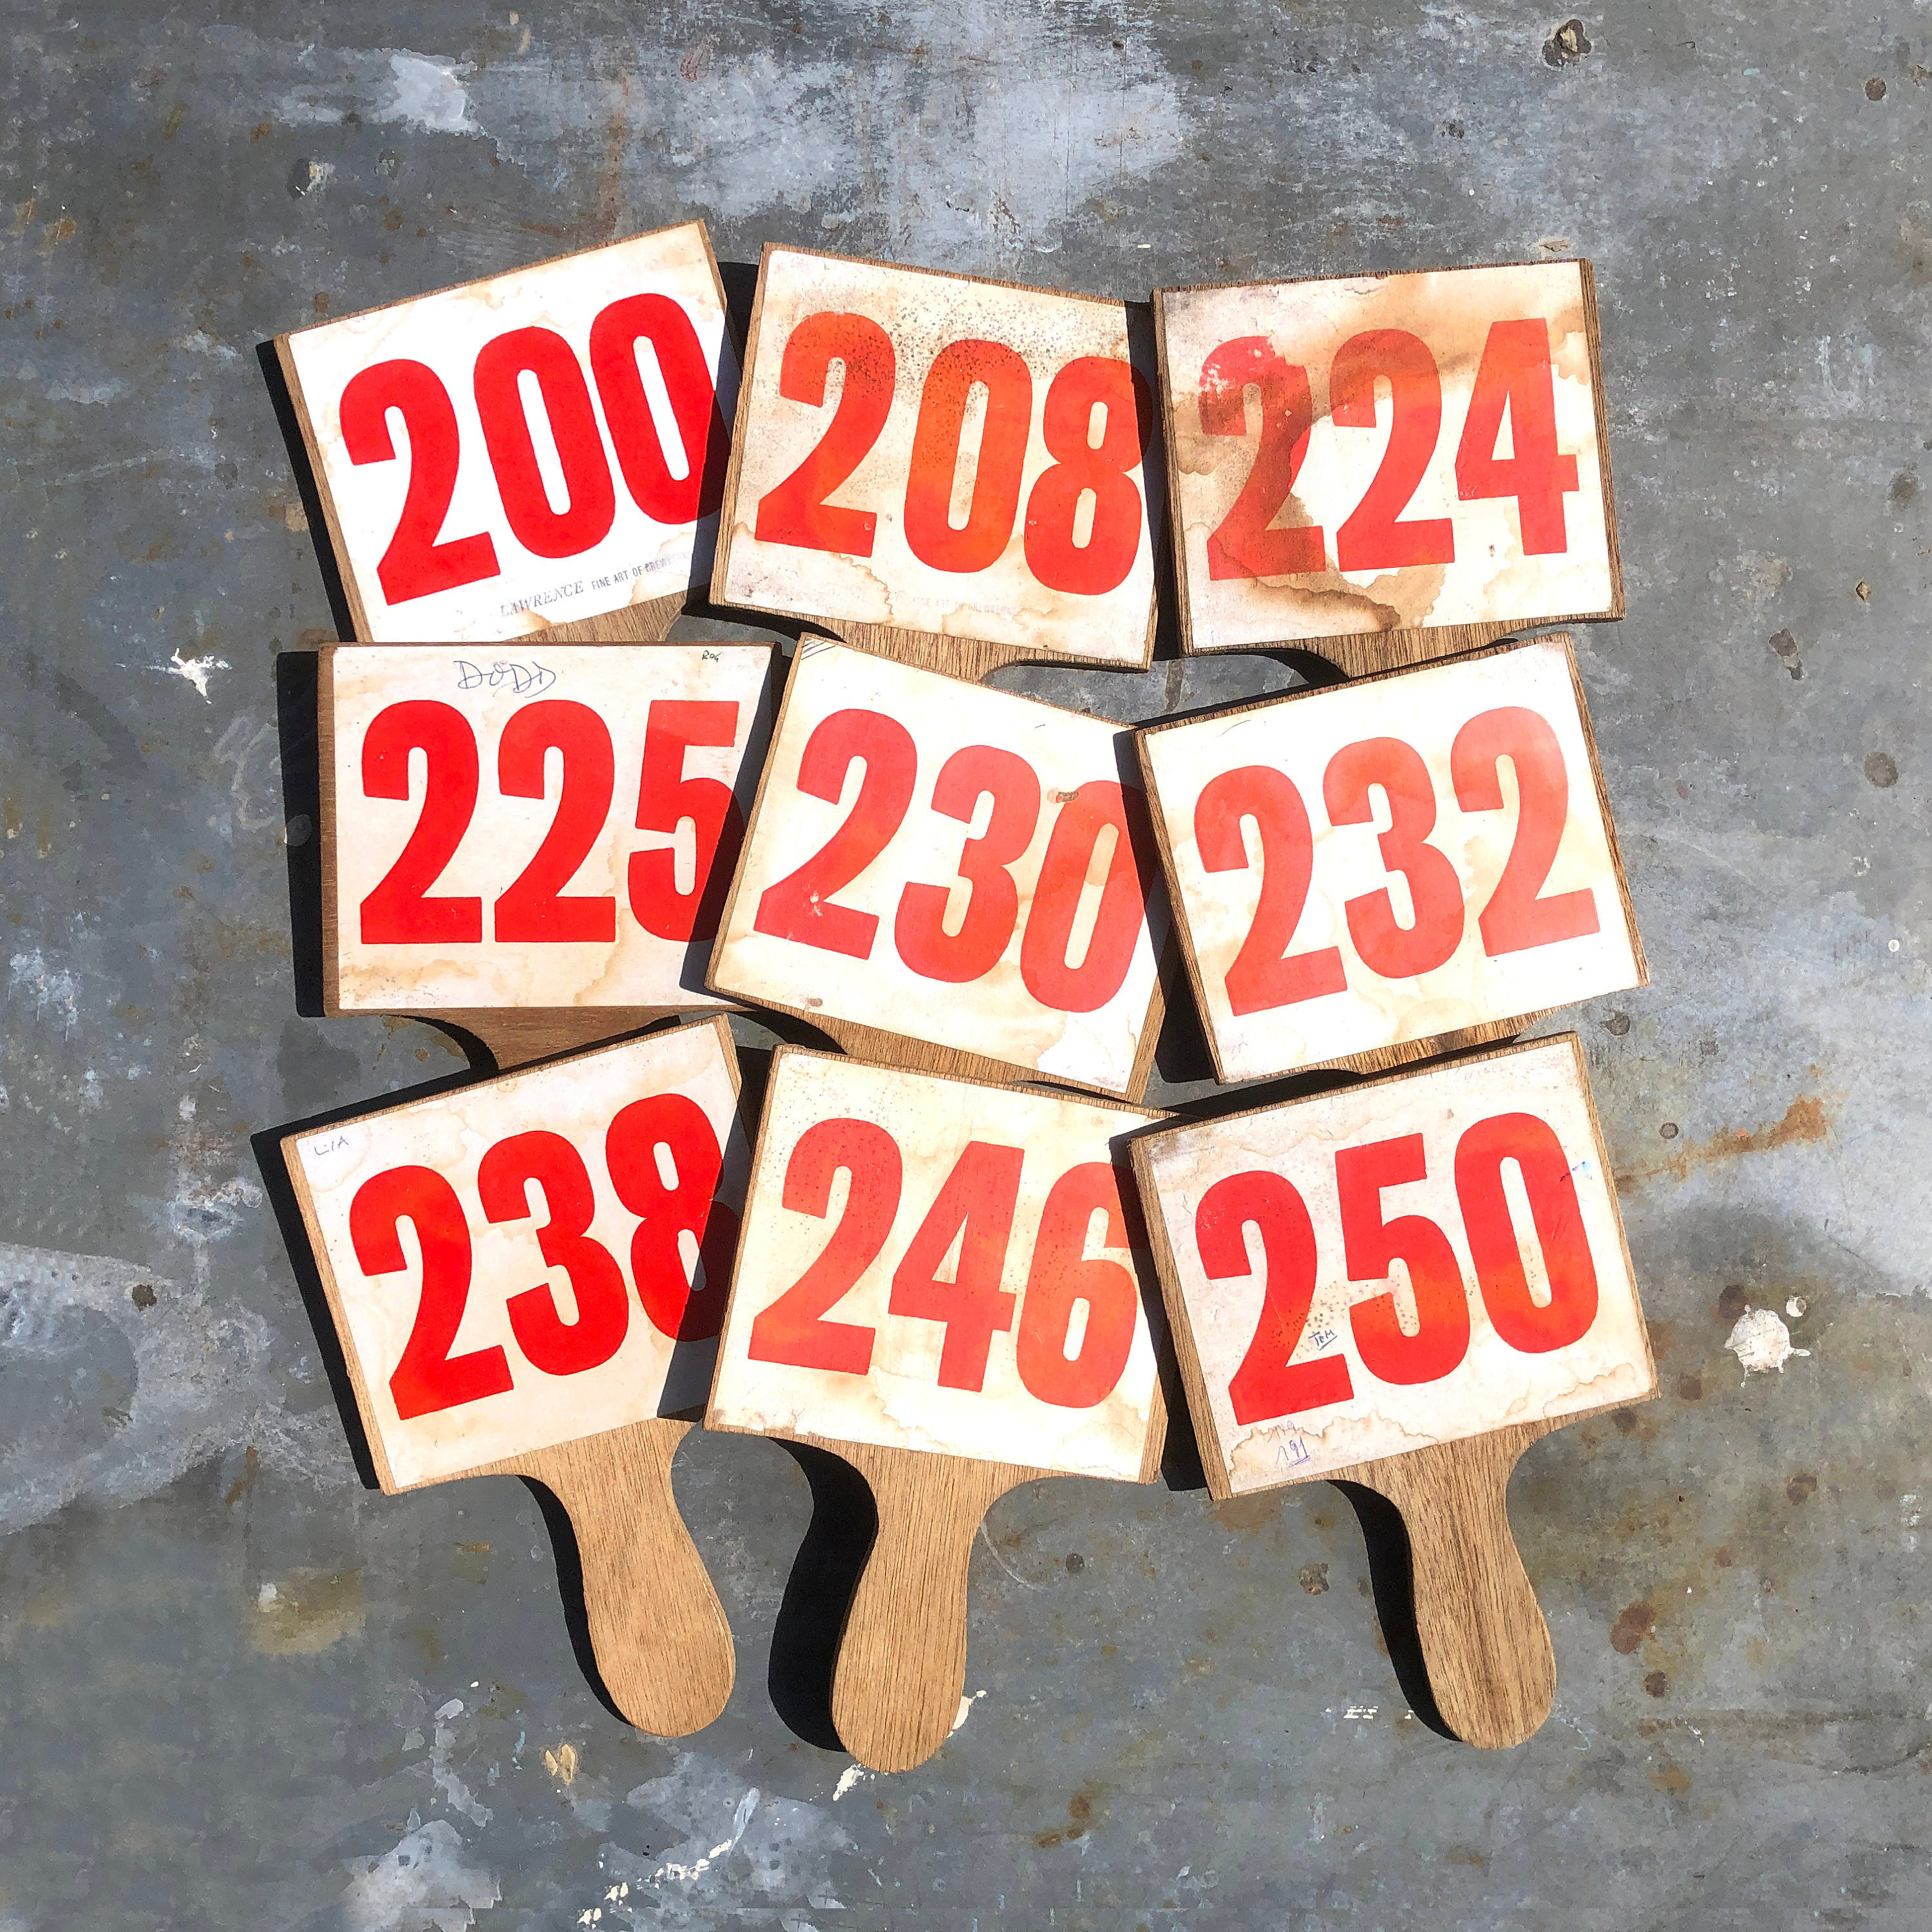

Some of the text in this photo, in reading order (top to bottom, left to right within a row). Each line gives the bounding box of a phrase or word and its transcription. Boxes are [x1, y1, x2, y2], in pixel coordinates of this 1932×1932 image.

[339, 293, 731, 606] 200
[500, 581, 584, 617] LAWRENCE
[591, 577, 611, 591] FINE
[614, 570, 629, 583] ART
[632, 565, 643, 577] OF
[755, 311, 1153, 596] 208
[1198, 317, 1580, 581] 224
[360, 699, 745, 945] 225
[753, 708, 1158, 1013] 230
[1195, 706, 1601, 1016] 232
[349, 1093, 741, 1421] 238
[748, 1117, 1149, 1408] 246
[1195, 1112, 1599, 1426] 250
